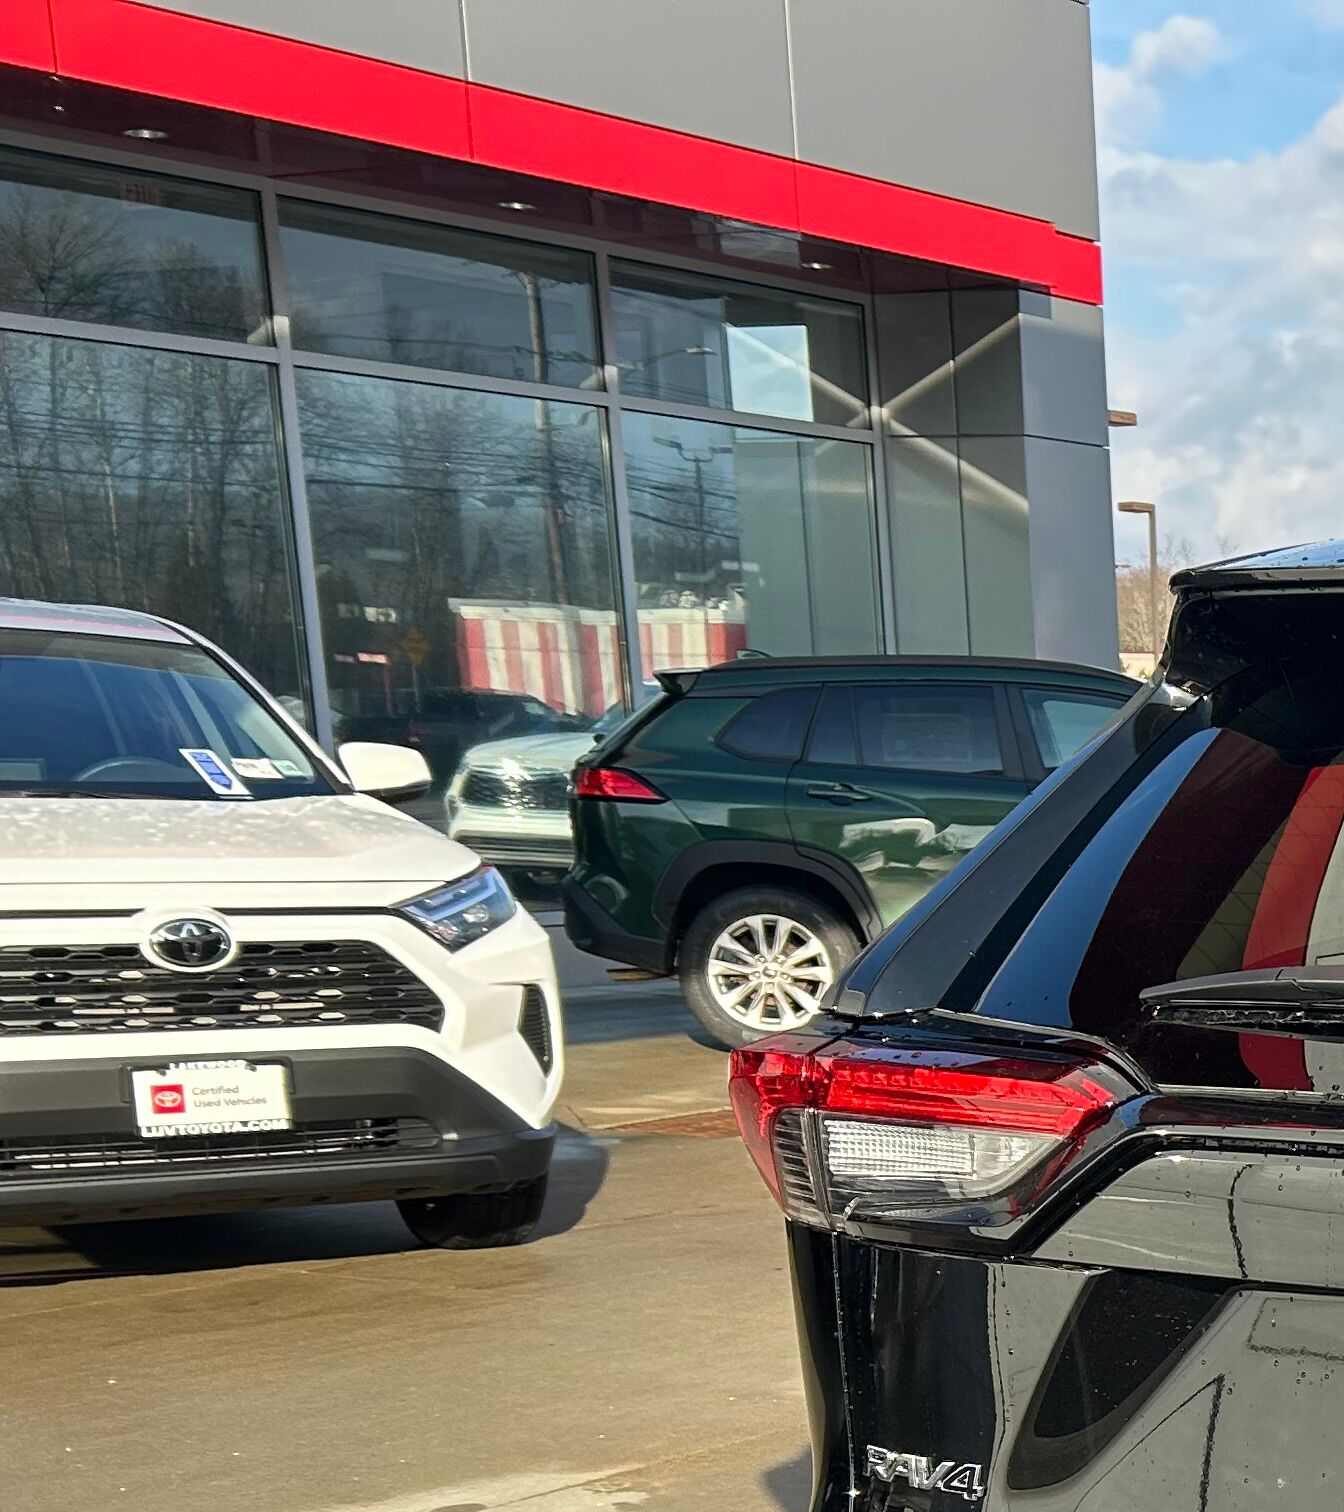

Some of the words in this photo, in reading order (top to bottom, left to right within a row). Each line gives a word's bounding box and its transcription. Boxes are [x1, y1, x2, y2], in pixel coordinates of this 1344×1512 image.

[192, 1085, 240, 1096] Certified
[193, 1098, 222, 1108] Used
[223, 1096, 267, 1106] Vehicles
[140, 1118, 290, 1138] LUVTOYOTA.COM
[865, 1444, 986, 1501] RAV4
